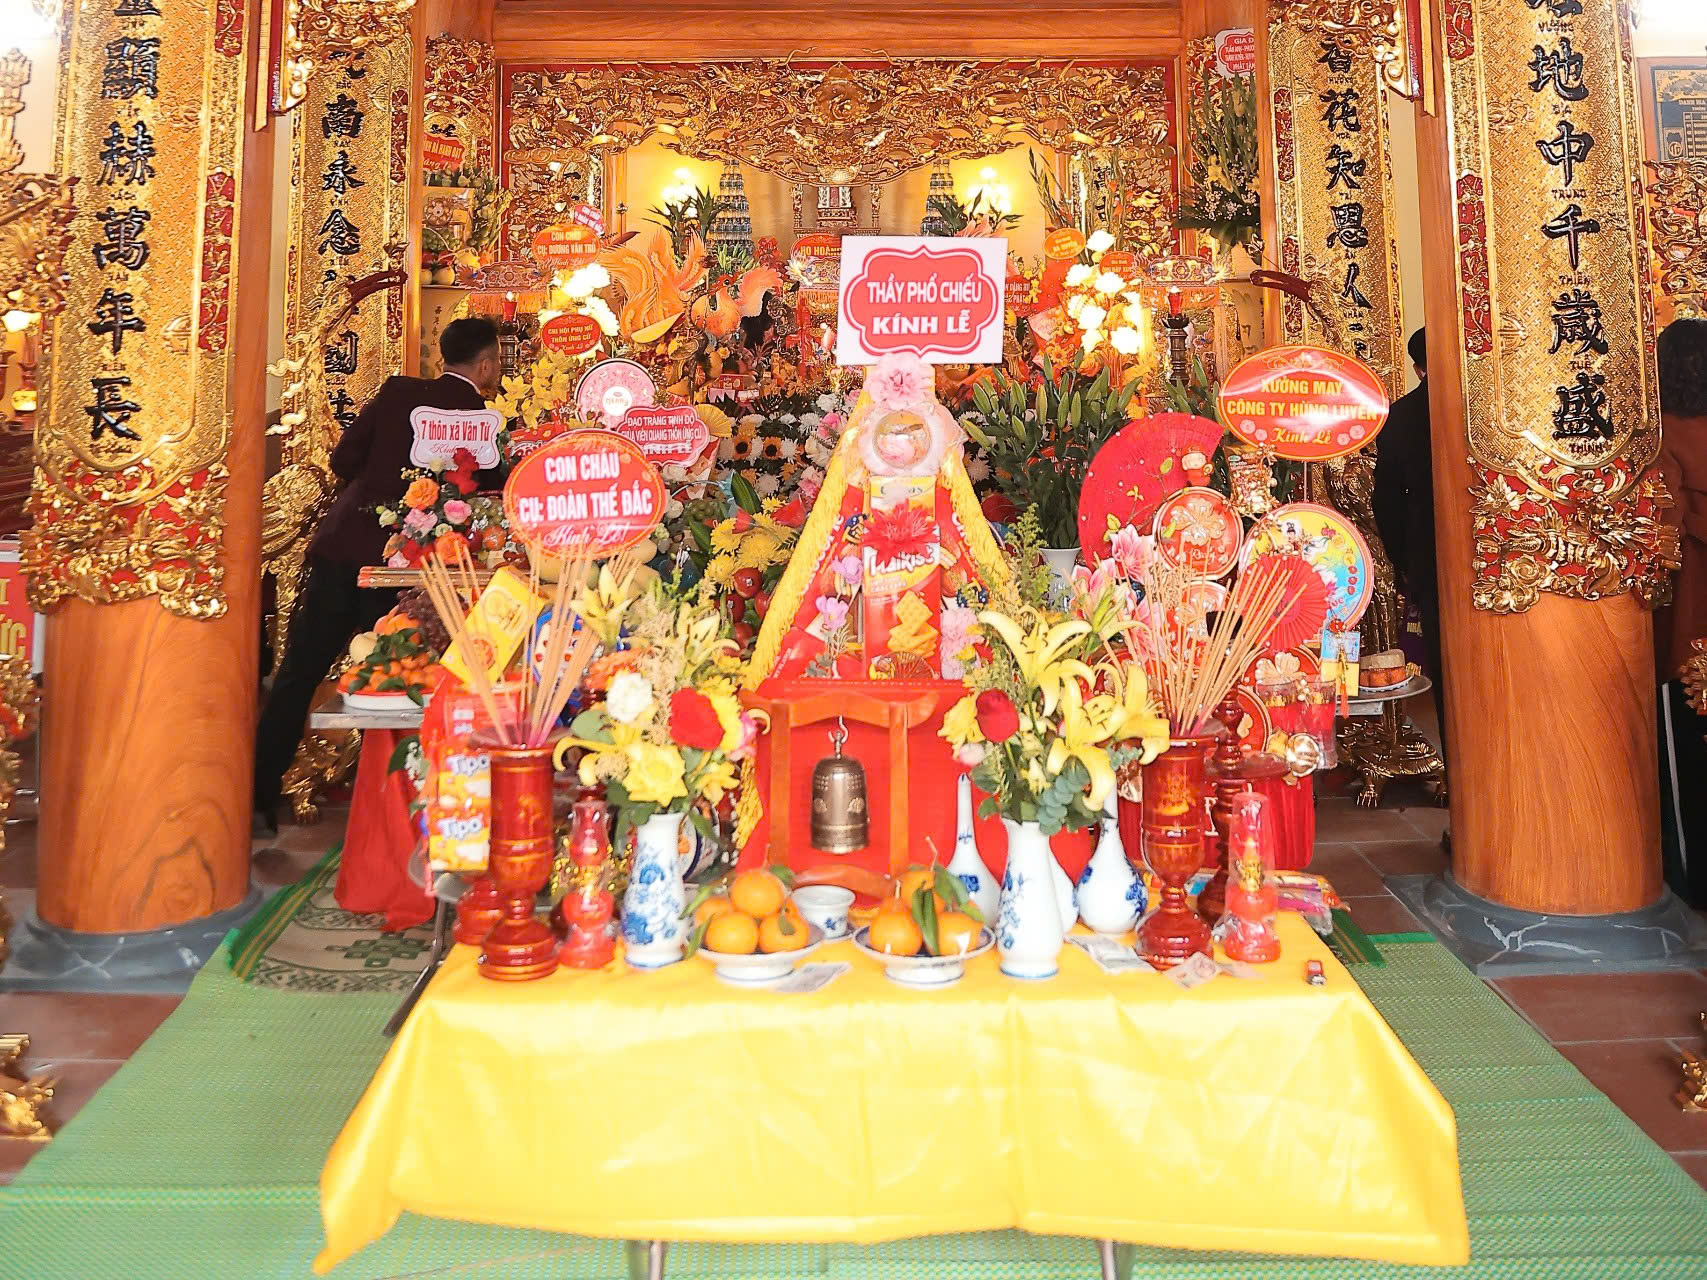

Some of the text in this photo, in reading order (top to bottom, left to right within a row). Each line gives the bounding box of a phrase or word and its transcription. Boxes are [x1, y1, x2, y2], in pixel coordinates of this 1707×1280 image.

[551, 231, 564, 241] CON
[867, 272, 982, 303] THẦY PHỔ CHIẾU
[872, 309, 971, 335] KÍNH LỄ
[1261, 376, 1344, 396] XƯỞNG MAY
[1227, 398, 1265, 416] CÔNG
[1269, 402, 1286, 417] TY
[421, 420, 427, 440] 7
[428, 419, 447, 440] thôn
[449, 421, 460, 440] xã
[462, 421, 478, 441] Vân
[627, 416, 643, 427] ĐẠO
[643, 415, 667, 426] TRÀNG
[544, 455, 577, 483] CON
[580, 449, 621, 480] CHÁU
[547, 489, 588, 521] ĐOÀN
[590, 483, 619, 518] THẾ
[621, 480, 652, 516] ĐẮC
[446, 753, 489, 777] Tipo
[436, 816, 482, 839] Tipo
